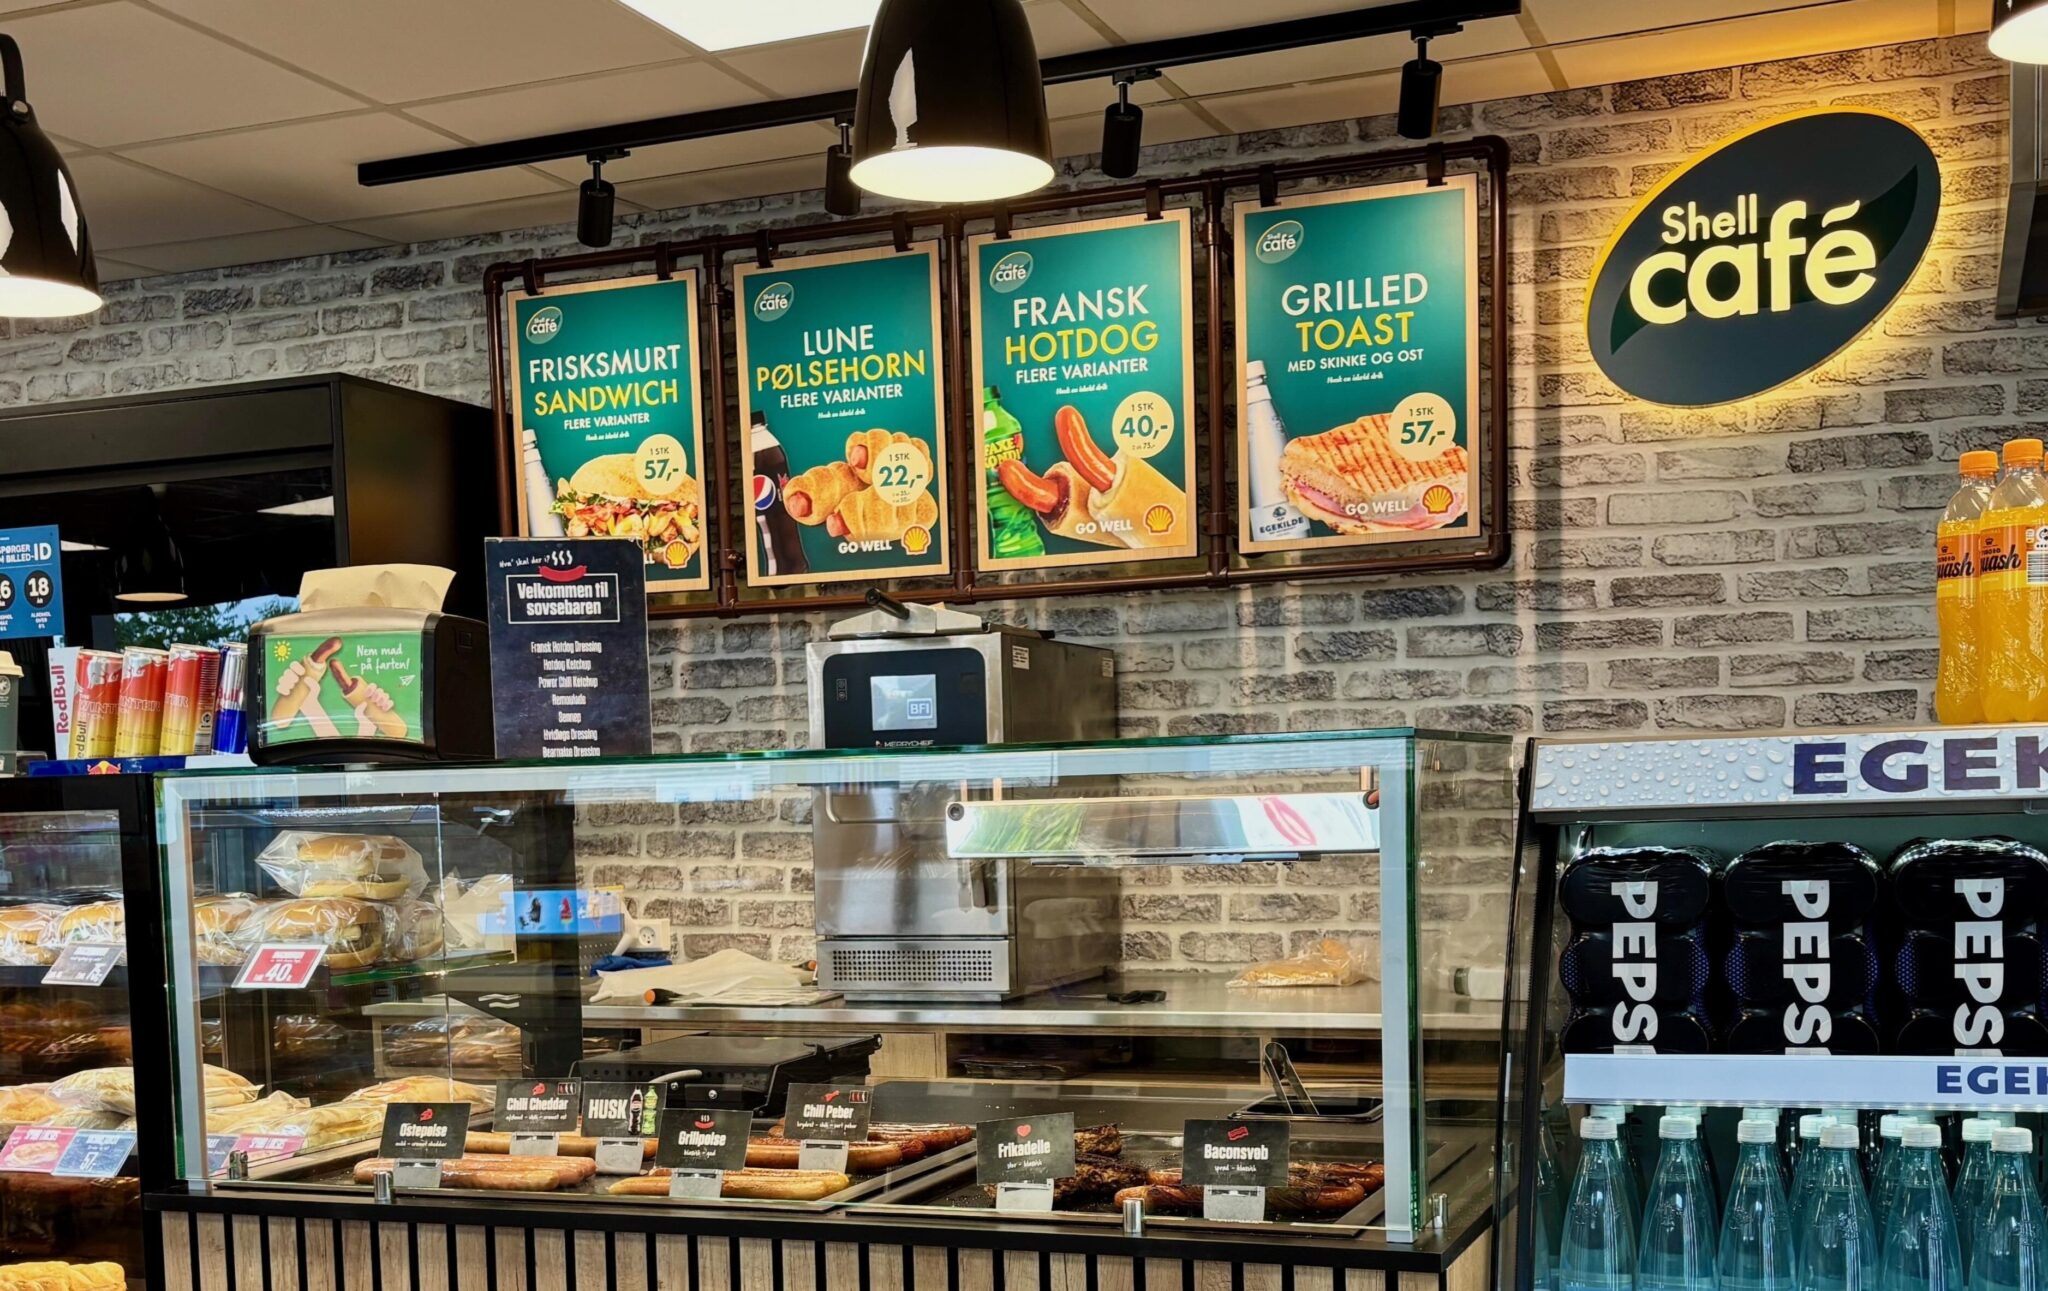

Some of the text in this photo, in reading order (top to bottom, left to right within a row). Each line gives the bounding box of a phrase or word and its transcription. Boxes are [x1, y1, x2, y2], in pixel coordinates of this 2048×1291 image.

[1662, 194, 1757, 244] Shell
[1262, 234, 1297, 252] café
[1630, 200, 1876, 325] café
[996, 264, 1026, 282] café
[760, 294, 788, 311] café
[1282, 272, 1428, 316] GRILLED
[1014, 284, 1149, 328] FRANSK
[531, 318, 558, 334] café
[1296, 311, 1414, 352] TOAST
[804, 324, 874, 356] LUNE
[1006, 320, 1158, 366] HOTDOG
[529, 344, 680, 384] FRISKSMURT
[1288, 349, 1424, 373] MED SKINKE OG OST
[756, 350, 926, 392] PØLSEHORN
[1016, 358, 1148, 384] FLERE VARIANTER
[534, 378, 678, 416] SANDWICH
[780, 384, 903, 408] FLERE VARIANTER
[1138, 402, 1154, 412] STK
[1416, 407, 1434, 416] STK
[564, 412, 650, 430] FLERE VARIANTER
[1120, 415, 1168, 440] 40,-
[1400, 420, 1446, 446] 57,-
[656, 446, 669, 455] STK
[895, 452, 910, 461] STK
[644, 458, 679, 482] 57,-
[879, 464, 924, 488] 22,-
[1345, 500, 1409, 516] GO WELL
[1075, 519, 1133, 535] GO WELL
[1260, 516, 1304, 534] EGEKILDE
[838, 539, 892, 554] GO WELL
[0, 580, 11, 599] 6
[28, 577, 50, 596] 18
[517, 582, 608, 599] Velkommen til
[526, 599, 602, 616] sovsebaren
[357, 643, 402, 657] Nem mad
[361, 658, 372, 675] på
[376, 658, 410, 675] farten!
[910, 703, 929, 714] BFI
[507, 1097, 568, 1110] Chili Cheddar
[588, 1099, 628, 1119] HUSK
[803, 1104, 854, 1119] Chili Peber
[998, 1139, 1050, 1158] Frikadelle
